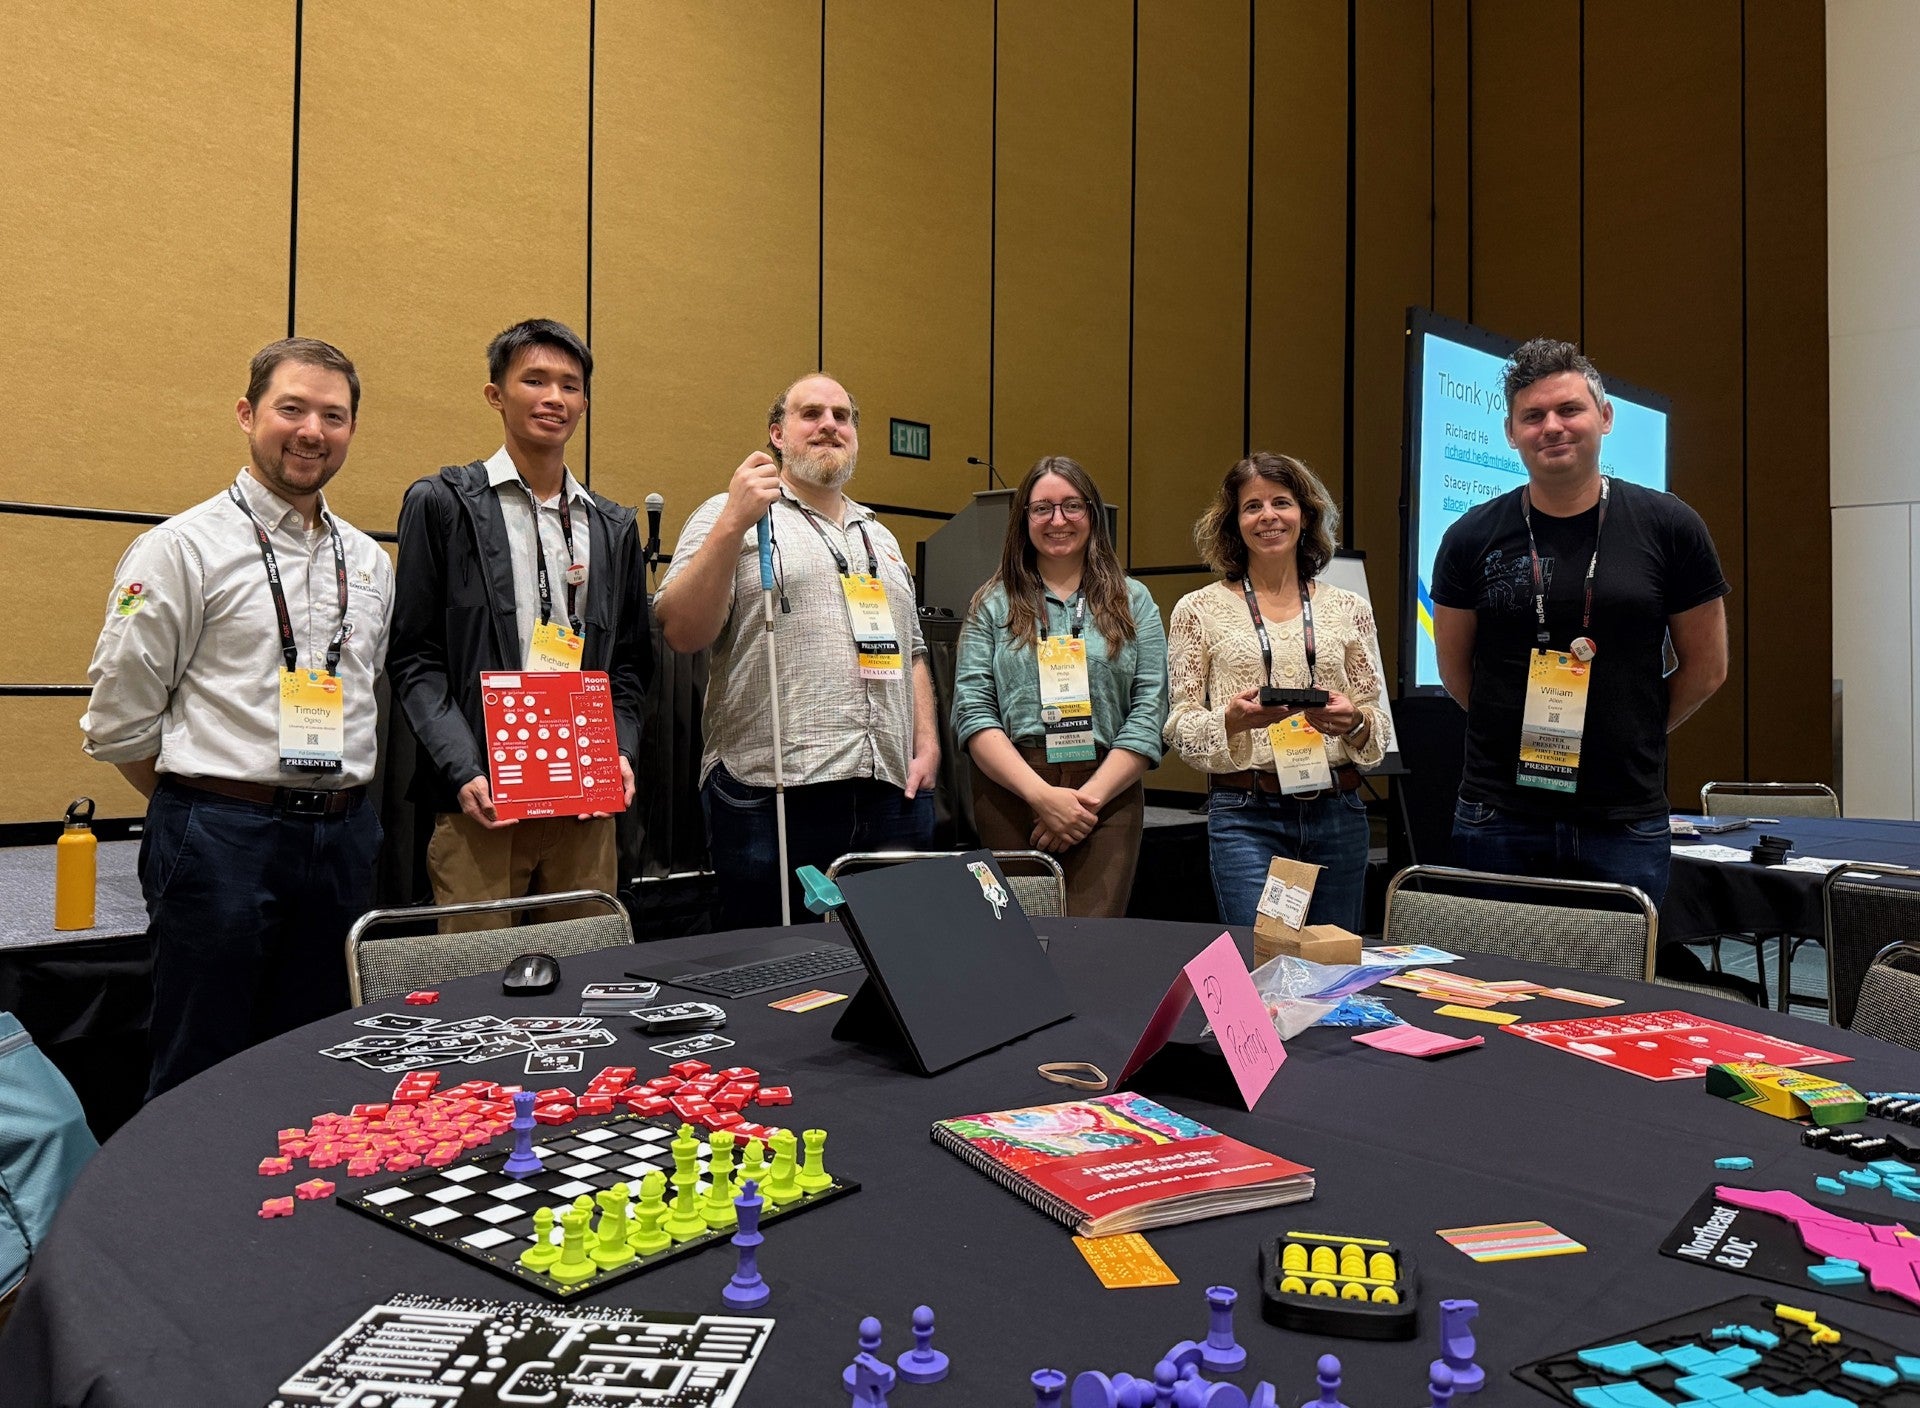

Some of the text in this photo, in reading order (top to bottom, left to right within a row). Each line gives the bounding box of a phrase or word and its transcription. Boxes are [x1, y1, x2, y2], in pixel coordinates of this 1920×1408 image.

[1438, 372, 1481, 406] Thank
[897, 424, 924, 455] EXIT
[1445, 423, 1489, 445] Richard He
[1444, 474, 1502, 498] Stacey Forsyth
[334, 534, 344, 561] imagne
[265, 552, 280, 584] imagne
[539, 569, 549, 598] imagne
[1536, 594, 1545, 624] imagne
[540, 653, 570, 669] Richard
[1540, 686, 1574, 697] William
[294, 705, 331, 718] Timothy
[1286, 746, 1312, 756] Stacey
[1532, 741, 1571, 750] PRESENTER
[286, 759, 337, 767] PRESENTER
[1524, 762, 1573, 774] PRESENTER
[1535, 754, 1566, 762] ATTENDEE
[1226, 1020, 1275, 1071] Printing
[540, 1055, 570, 1063] 49
[1081, 1150, 1213, 1176] Juniper and the
[1098, 1157, 1220, 1182] Red Swoosh
[1086, 1184, 1138, 1201] Chi-Hoon
[1138, 1179, 1161, 1188] Kim
[1161, 1175, 1183, 1184] and
[1184, 1169, 1222, 1180] Juniper
[1677, 1205, 1740, 1260] Northeast
[1714, 1236, 1758, 1268] & DC
[386, 1299, 643, 1323] MOUNTAIN LAKES PUBLIC LIBRARY
